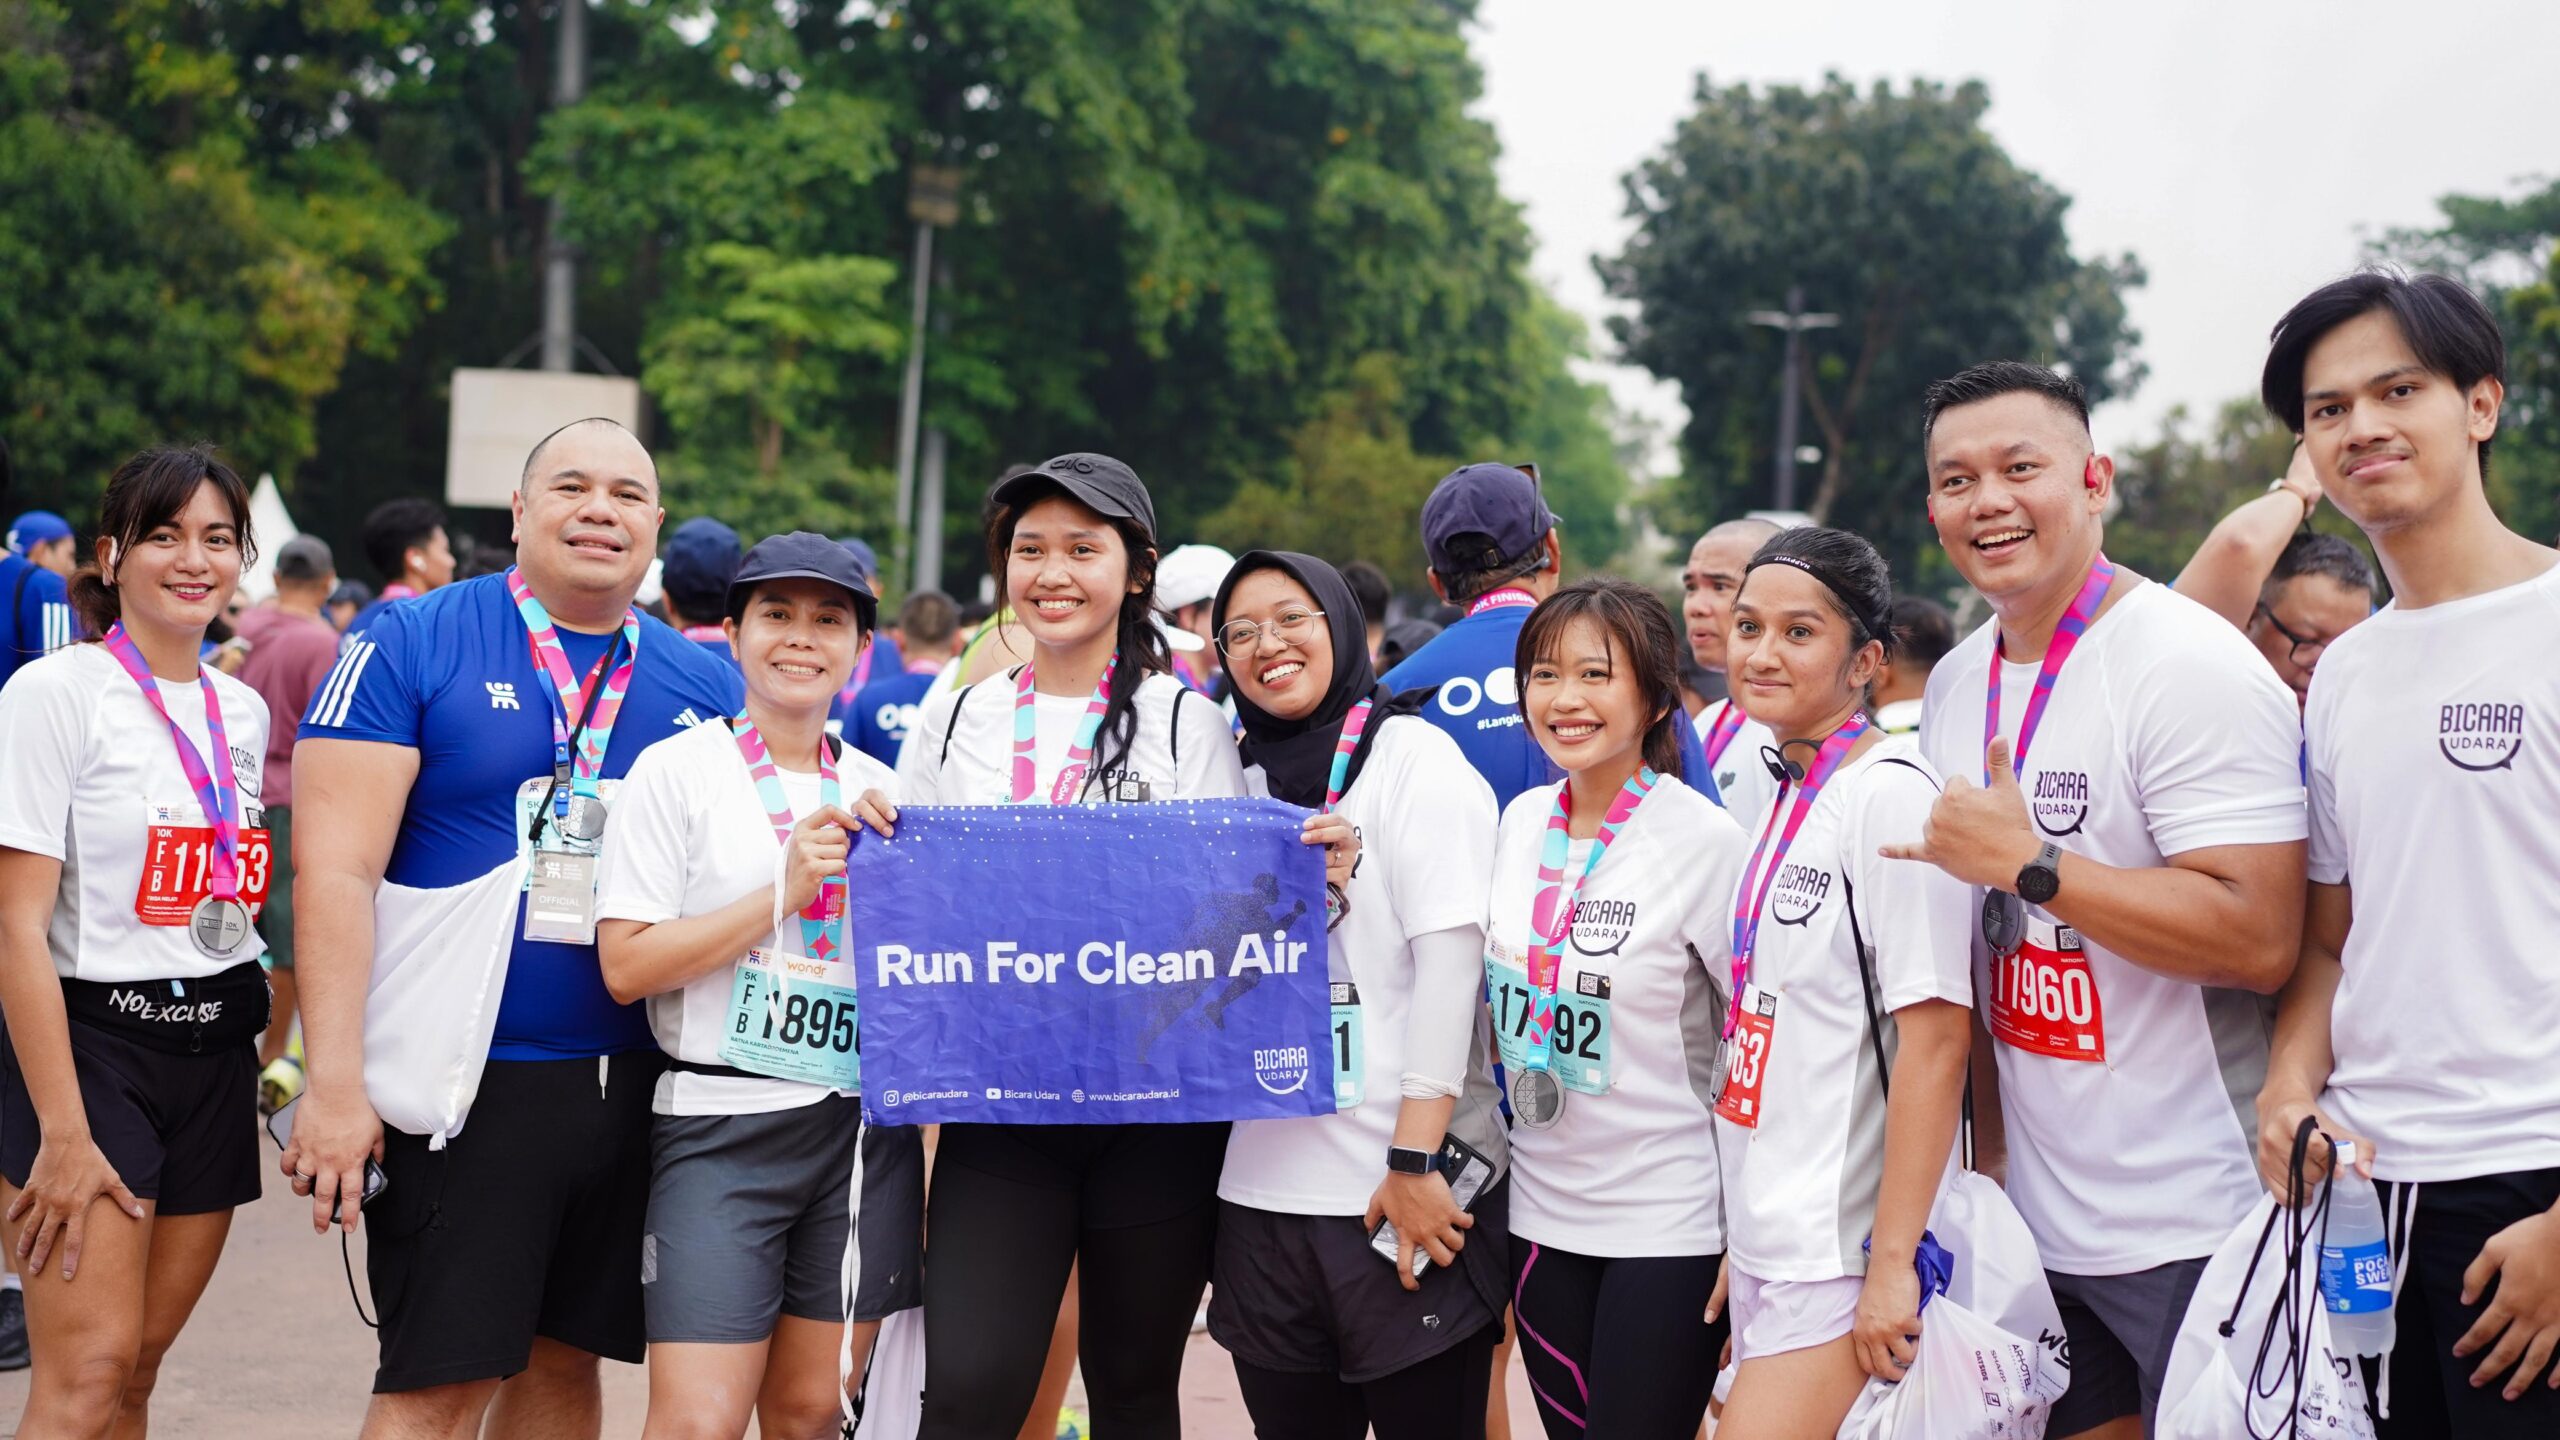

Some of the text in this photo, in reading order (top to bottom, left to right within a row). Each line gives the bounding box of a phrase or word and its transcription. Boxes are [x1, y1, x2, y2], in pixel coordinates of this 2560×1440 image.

[2440, 703, 2523, 734] BICARA
[2450, 737, 2507, 750] UDARA
[231, 747, 258, 775] ICARA
[2034, 771, 2088, 800] BICARA
[2038, 803, 2077, 815] UDARA
[157, 828, 172, 837] 10K
[539, 895, 580, 906] OFFICIAL
[1573, 900, 1636, 927] BICARA
[1576, 927, 1619, 939] UDARA
[788, 961, 827, 976] wondr
[877, 930, 1307, 987] Run For Clean Air
[744, 971, 757, 981] 5K
[743, 984, 755, 1005] F
[1997, 954, 2093, 1025] 11960
[736, 1012, 748, 1034] B
[763, 990, 861, 1056] 1895
[1254, 1046, 1308, 1070] BICARA
[1263, 1070, 1300, 1080] UDARA
[903, 1089, 968, 1103] @bicaraudara
[1005, 1089, 1060, 1100] Bicara Udara
[1089, 1089, 1179, 1102] www.bicaraudara.id
[1975, 1350, 1988, 1381] OATSIDE
[1990, 1350, 2006, 1383] SHARP
